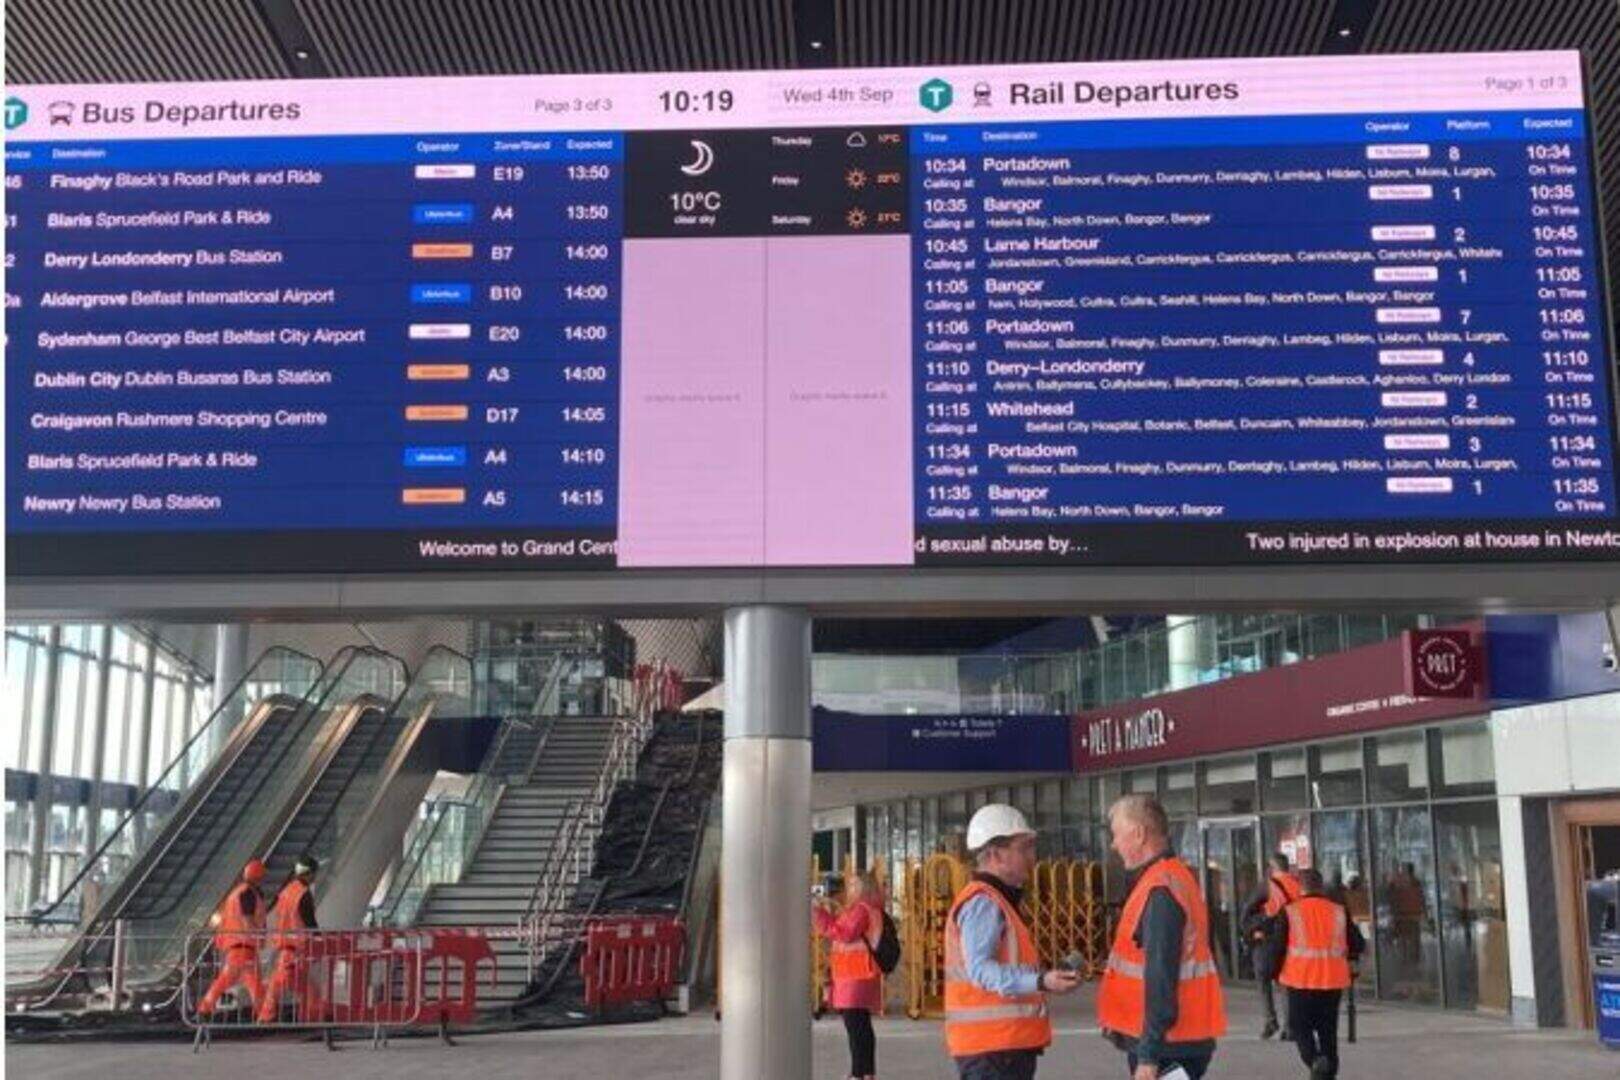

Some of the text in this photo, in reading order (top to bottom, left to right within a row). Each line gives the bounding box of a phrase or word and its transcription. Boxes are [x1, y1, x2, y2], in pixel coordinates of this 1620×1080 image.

[1485, 77, 1523, 92] Page
[1527, 77, 1534, 89] 1
[1540, 76, 1554, 89] of
[660, 90, 733, 112] 10:19
[783, 87, 893, 103] Wed 4th Sep
[930, 88, 942, 106] T
[1010, 81, 1239, 107] Rail Departures
[83, 100, 300, 126] Bus Departures
[535, 98, 613, 113] Page 3 of 3
[1365, 118, 1572, 132] Operator Platform Expected
[924, 132, 1037, 142] Time Destination
[417, 141, 459, 153] Operator
[567, 139, 613, 150] Expected
[1527, 144, 1570, 159] 10:34
[1449, 147, 1460, 161] 8
[926, 159, 966, 173] 10:34
[984, 157, 1070, 171] Portadown
[51, 169, 322, 190] Finaghy Black's Road Park and Ride
[494, 167, 523, 180] E19
[568, 165, 609, 180] 13:50
[1453, 187, 1460, 200] 1
[1531, 185, 1574, 199] 10:35
[671, 192, 720, 211] 10°C
[925, 199, 967, 213] 10:35
[984, 197, 1042, 214] Bangor
[48, 210, 271, 228] Blaris Sprucefield Park & Ride
[492, 207, 513, 219] A4
[567, 205, 608, 219] 13:50
[674, 216, 715, 225] clear sky
[1455, 228, 1465, 242] 2
[1534, 225, 1578, 240] 10:45
[926, 239, 967, 253] 10:45
[1034, 236, 1100, 250] Harbour
[45, 249, 282, 269] Derry Londonderry Bus Station
[492, 246, 513, 260] B7
[567, 245, 608, 259] 14:00
[1459, 269, 1466, 282] 1
[1537, 267, 1581, 281] 11:05
[490, 286, 521, 300] B10
[565, 285, 607, 299] 14:00
[926, 279, 968, 293] 11:05
[985, 278, 1044, 295] Bangor
[41, 289, 334, 308] Aldergrove Belfast International Airport
[1461, 310, 1471, 324] 7
[1540, 309, 1584, 323] 11:06
[489, 326, 519, 341] E20
[565, 326, 607, 339] 14:00
[926, 320, 969, 334] 11:06
[986, 319, 1074, 334] Portadown
[38, 328, 365, 349] Sydenham George Best Belfast City Airport
[1464, 352, 1474, 366] 4
[1543, 350, 1588, 365] 11:10
[487, 367, 509, 381] A3
[564, 367, 606, 380] 14:00
[927, 362, 970, 375] 11:10
[35, 369, 331, 389] Dublin City Dublin Busaras Bus Station
[1467, 394, 1477, 409] 2
[1546, 393, 1591, 408] 11:15
[487, 408, 518, 423] D17
[563, 408, 605, 421] 14:05
[927, 403, 970, 417] 11:15
[986, 401, 1073, 416] Whitehead
[31, 410, 327, 430] Craigavon Rushmere Shopping Centre
[988, 443, 1077, 458] Portadown
[1470, 437, 1481, 452] 3
[1550, 436, 1595, 451] 11:34
[485, 450, 506, 463] A4
[562, 449, 604, 463] 14:10
[928, 444, 970, 459] 11:34
[28, 452, 257, 471] Blaris Sprucefield Park & Ride
[929, 486, 971, 500] 11:35
[1473, 480, 1482, 494] 1
[1554, 478, 1599, 493] 11:35
[483, 491, 505, 505] A5
[562, 490, 603, 505] 14:15
[988, 485, 1048, 502] Bangor
[24, 494, 221, 513] Newry Newry Bus Station
[420, 538, 619, 556] Welcome to Grand Cent
[931, 537, 986, 552] sexual
[991, 536, 1044, 551] abuse
[1247, 533, 1284, 549] Two
[1289, 533, 1349, 552] injured
[1354, 533, 1370, 548] in
[1375, 532, 1459, 552] explosion
[1464, 532, 1481, 547] at
[1485, 532, 1540, 547] house
[1545, 531, 1561, 546] in
